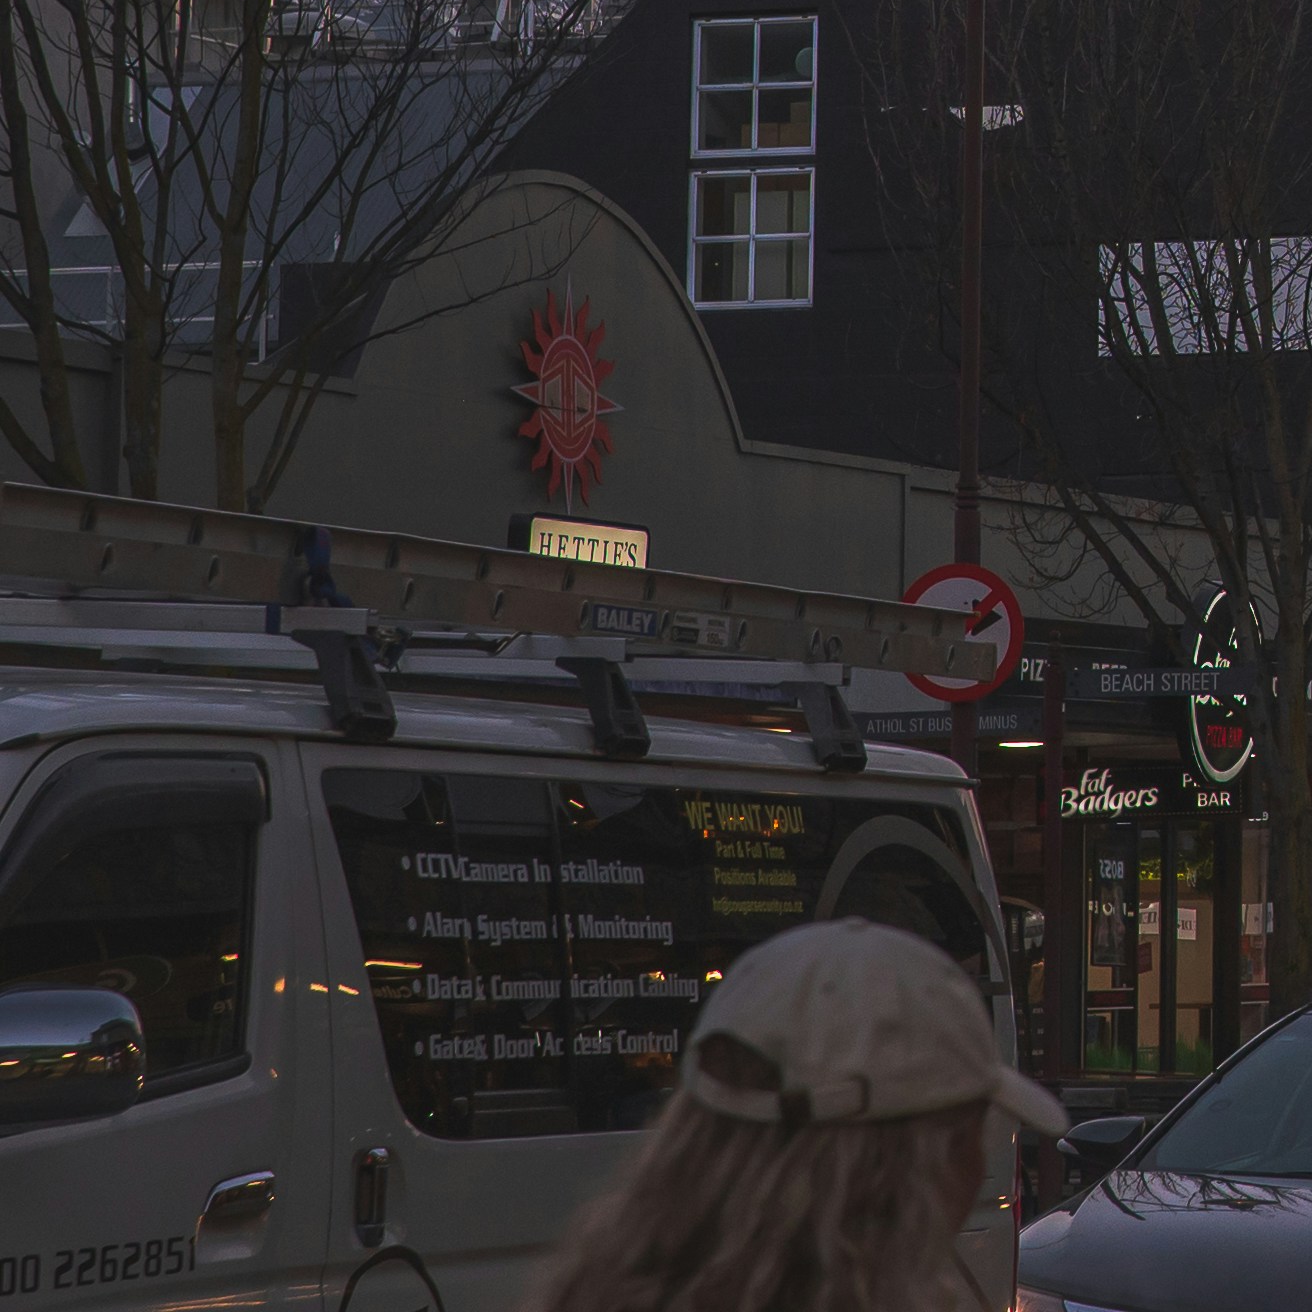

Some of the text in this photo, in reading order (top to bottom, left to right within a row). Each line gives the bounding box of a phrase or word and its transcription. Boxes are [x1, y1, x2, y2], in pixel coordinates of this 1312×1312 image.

[539, 532, 638, 567] HETTIE'S
[597, 606, 655, 634] BAILEY
[1101, 672, 1220, 693] BEACH STREET
[866, 718, 906, 734] ATHOL
[909, 718, 924, 733] ST
[928, 717, 952, 732] BUS
[1080, 768, 1112, 795] Fat
[1061, 785, 1159, 818] Badgers
[1197, 792, 1231, 807] BAR
[685, 801, 806, 834] WE WANT YOU!
[716, 841, 735, 858] Part
[763, 842, 786, 860] Time
[416, 852, 461, 879] CCTV
[460, 857, 529, 883] Camera
[714, 867, 798, 886] Positions Available
[477, 914, 547, 946] System
[578, 914, 674, 946] Monitoring
[426, 974, 472, 1000] Data
[638, 974, 699, 1002] Cabling
[493, 1034, 536, 1060] Door
[617, 1029, 679, 1055] Control
[54, 1235, 197, 1289] 2262851
